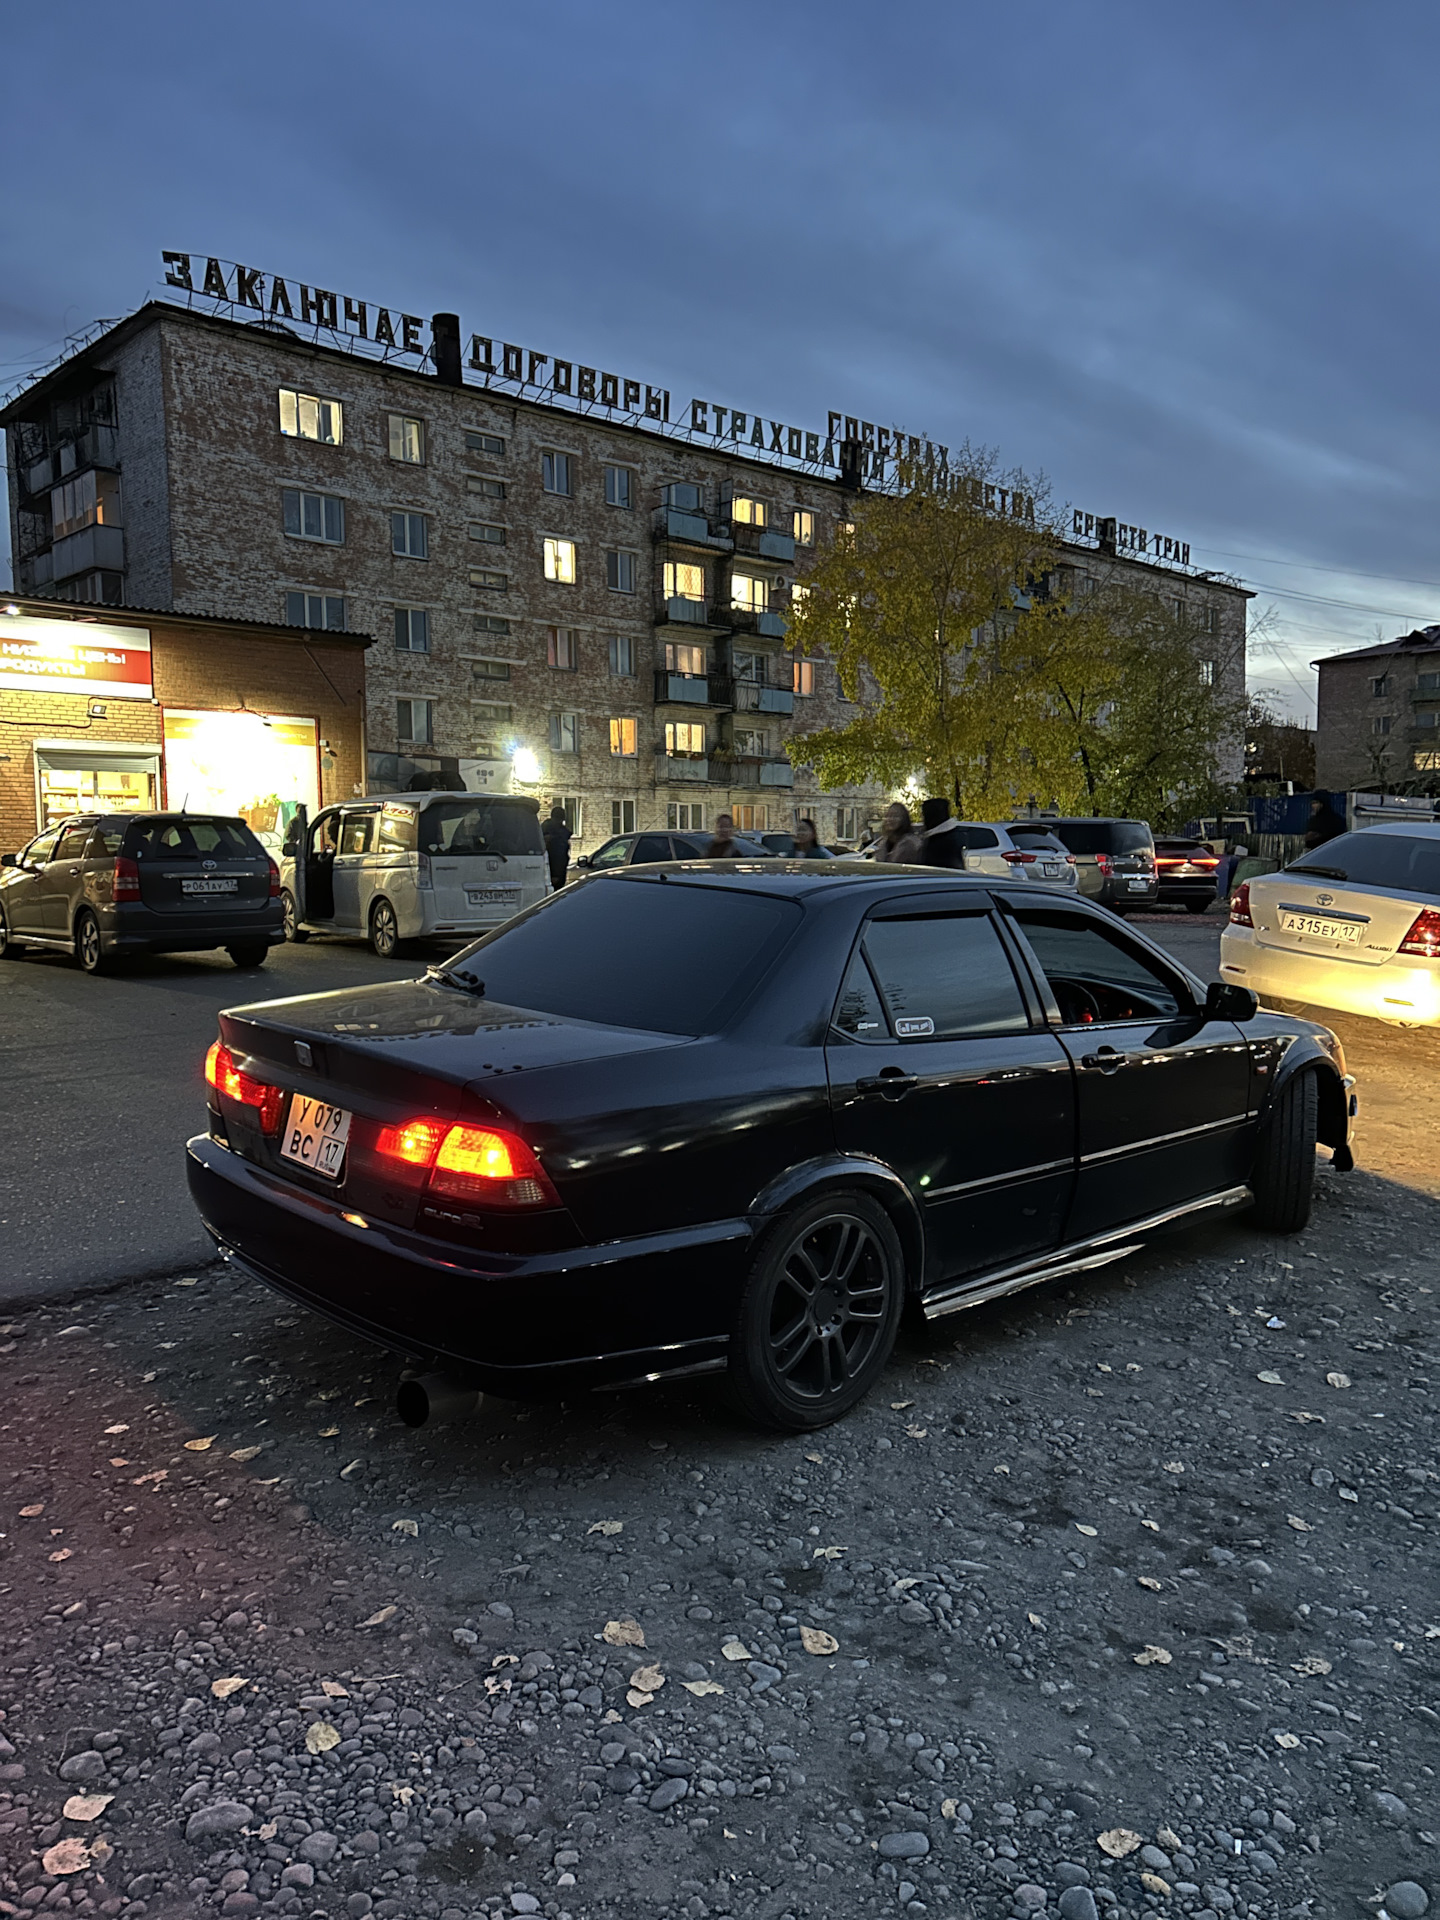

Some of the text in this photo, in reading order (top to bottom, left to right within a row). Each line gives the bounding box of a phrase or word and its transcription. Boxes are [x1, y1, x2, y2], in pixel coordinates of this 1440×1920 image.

[162, 250, 449, 359] ЗАКЛЮЧАЕ
[468, 333, 670, 422] ДОГОВОРЫ
[1154, 533, 1191, 565] ТРАН
[0, 656, 86, 676] РОДУКТЫ
[1342, 926, 1355, 937] 17
[289, 1129, 339, 1163] ВС 17
